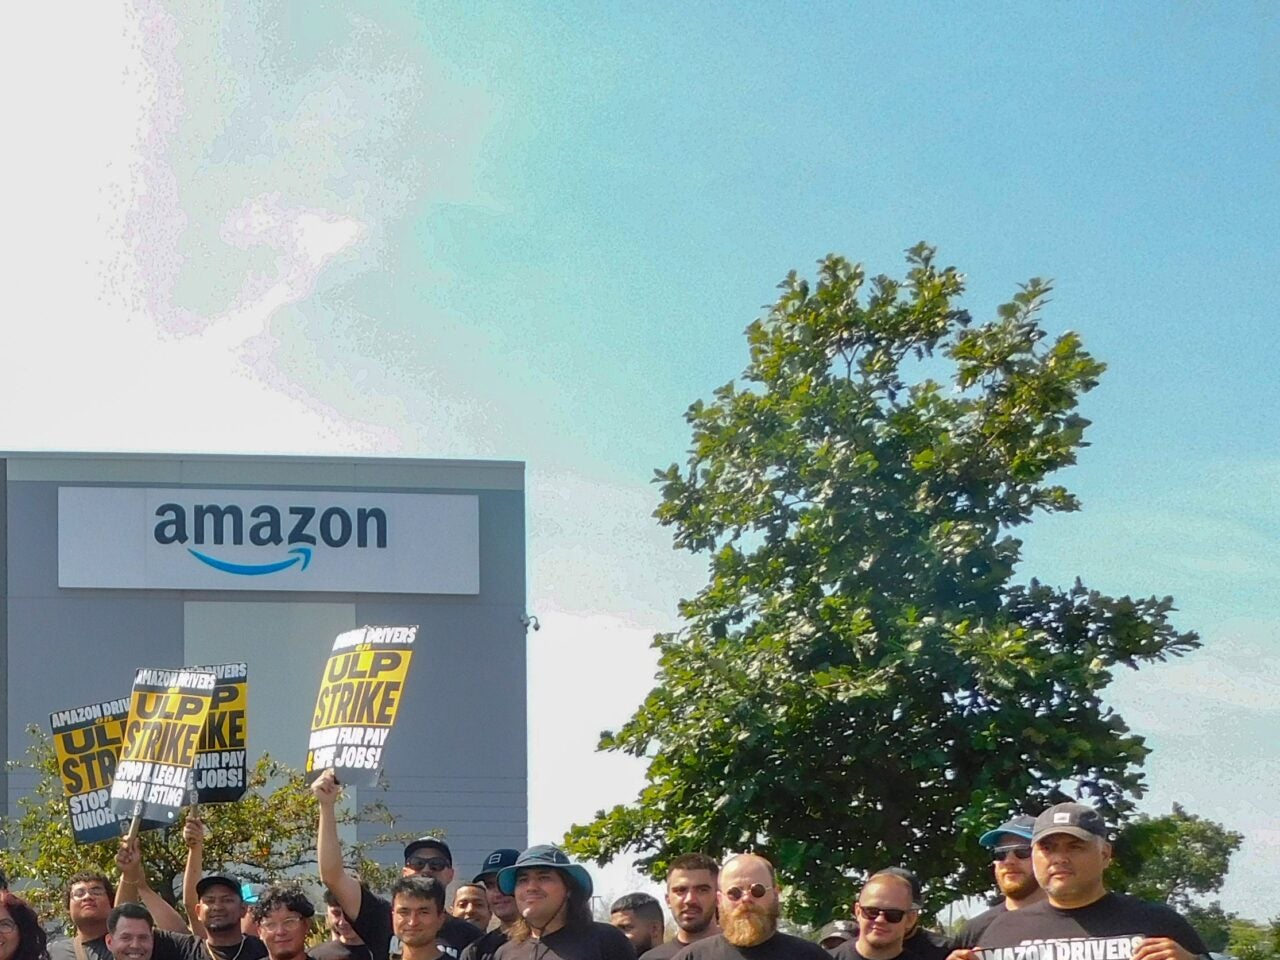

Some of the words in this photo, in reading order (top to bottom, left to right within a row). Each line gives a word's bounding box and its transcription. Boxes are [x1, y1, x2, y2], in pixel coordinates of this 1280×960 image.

[154, 502, 388, 548] amazon
[366, 627, 416, 643] DRIVERS
[328, 652, 402, 682] ULP
[136, 669, 177, 687] AMAZON
[177, 672, 216, 689] DRIVERS
[137, 693, 203, 720] ULP
[315, 681, 401, 727] STRIKE
[52, 705, 101, 728] AMAZON
[62, 720, 126, 755] UL
[124, 720, 199, 766] STRIKE
[338, 728, 364, 745] FAIR
[364, 728, 389, 745] PAY
[194, 753, 220, 769] FAIR
[222, 751, 245, 767] PAY
[335, 747, 382, 768] JOBS!
[197, 769, 242, 789] JOBS!
[70, 790, 109, 814] STOP
